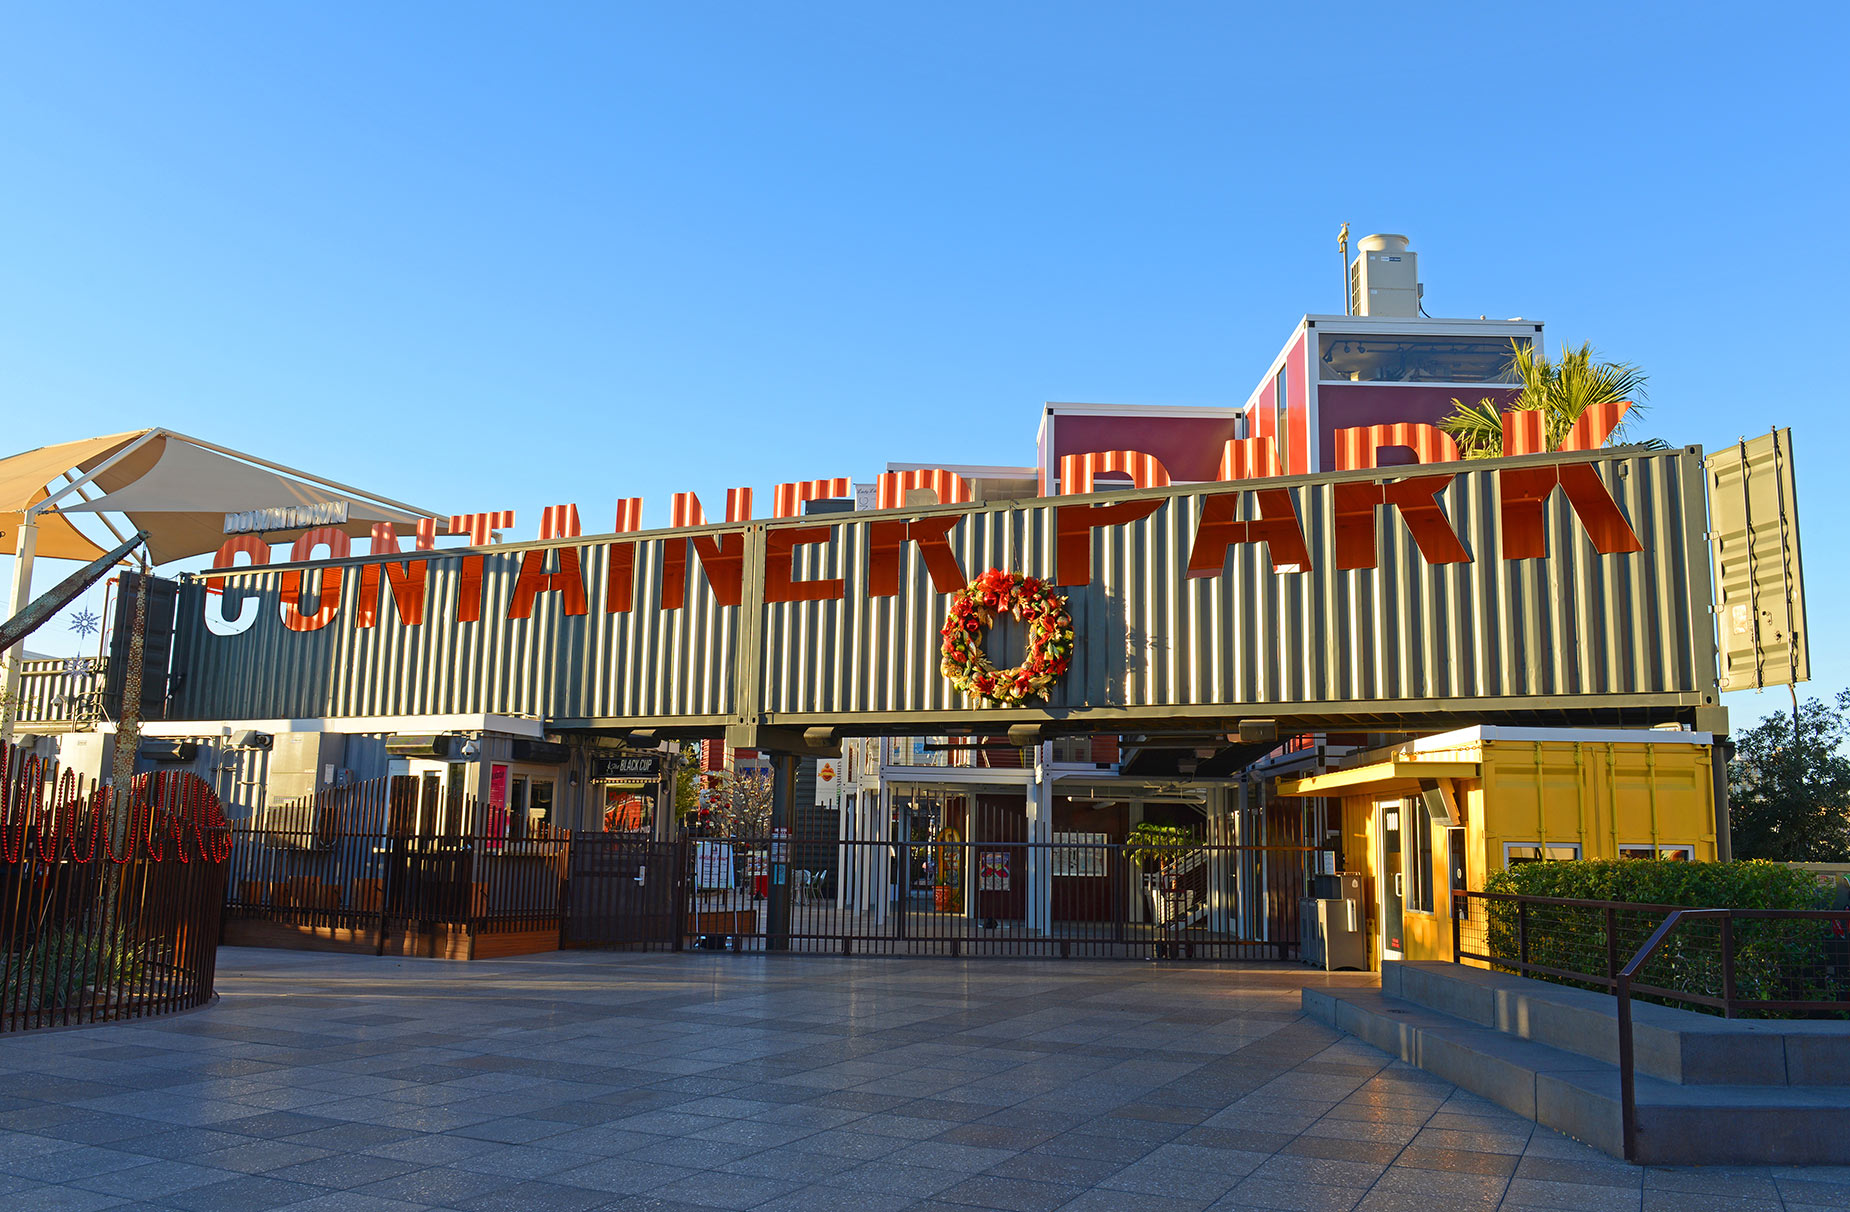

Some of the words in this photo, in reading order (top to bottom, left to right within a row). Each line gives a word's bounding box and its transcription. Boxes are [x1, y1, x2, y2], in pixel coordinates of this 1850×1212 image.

[203, 468, 968, 636] CONTAINER
[1056, 400, 1645, 586] PARK
[223, 501, 350, 535] DOWNTOWN
[620, 759, 639, 772] BLACK
[639, 759, 653, 771] CUP
